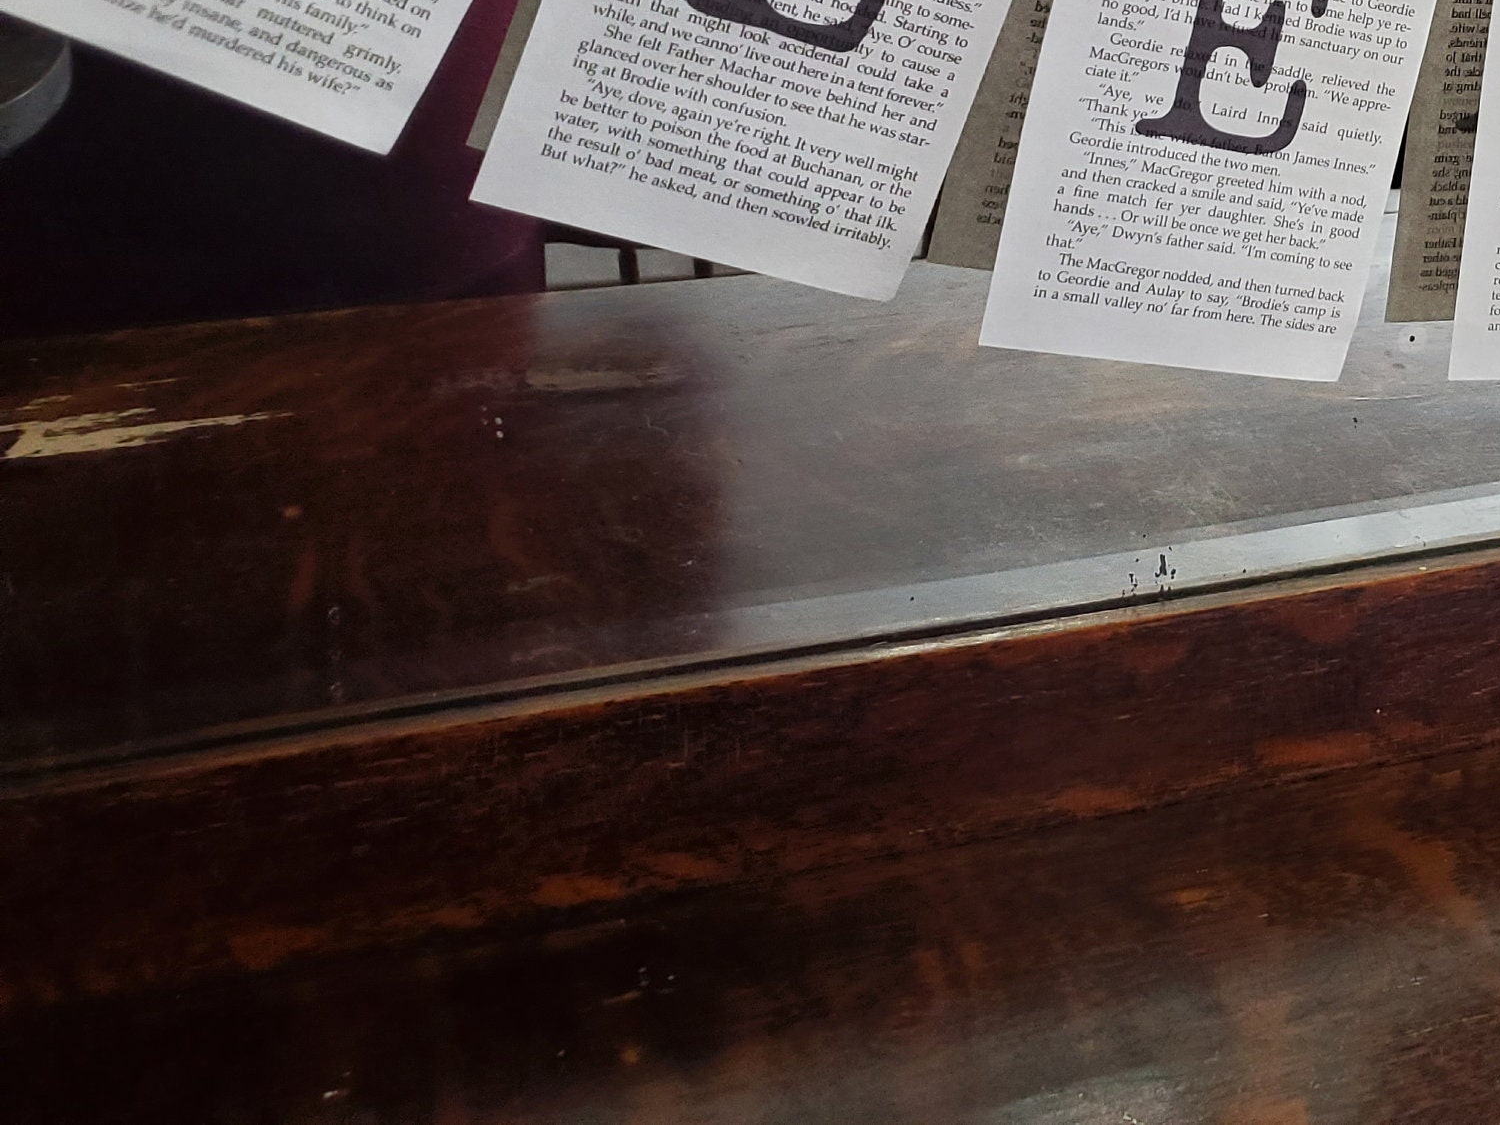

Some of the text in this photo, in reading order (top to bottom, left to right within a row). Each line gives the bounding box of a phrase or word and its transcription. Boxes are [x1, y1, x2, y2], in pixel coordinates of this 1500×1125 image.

[572, 57, 787, 128] ing at Brodie with confusion.
[1069, 131, 1281, 177] Geordie introduced the two men.
[1033, 285, 1337, 335] in a small valley no' far from here. The sides are
